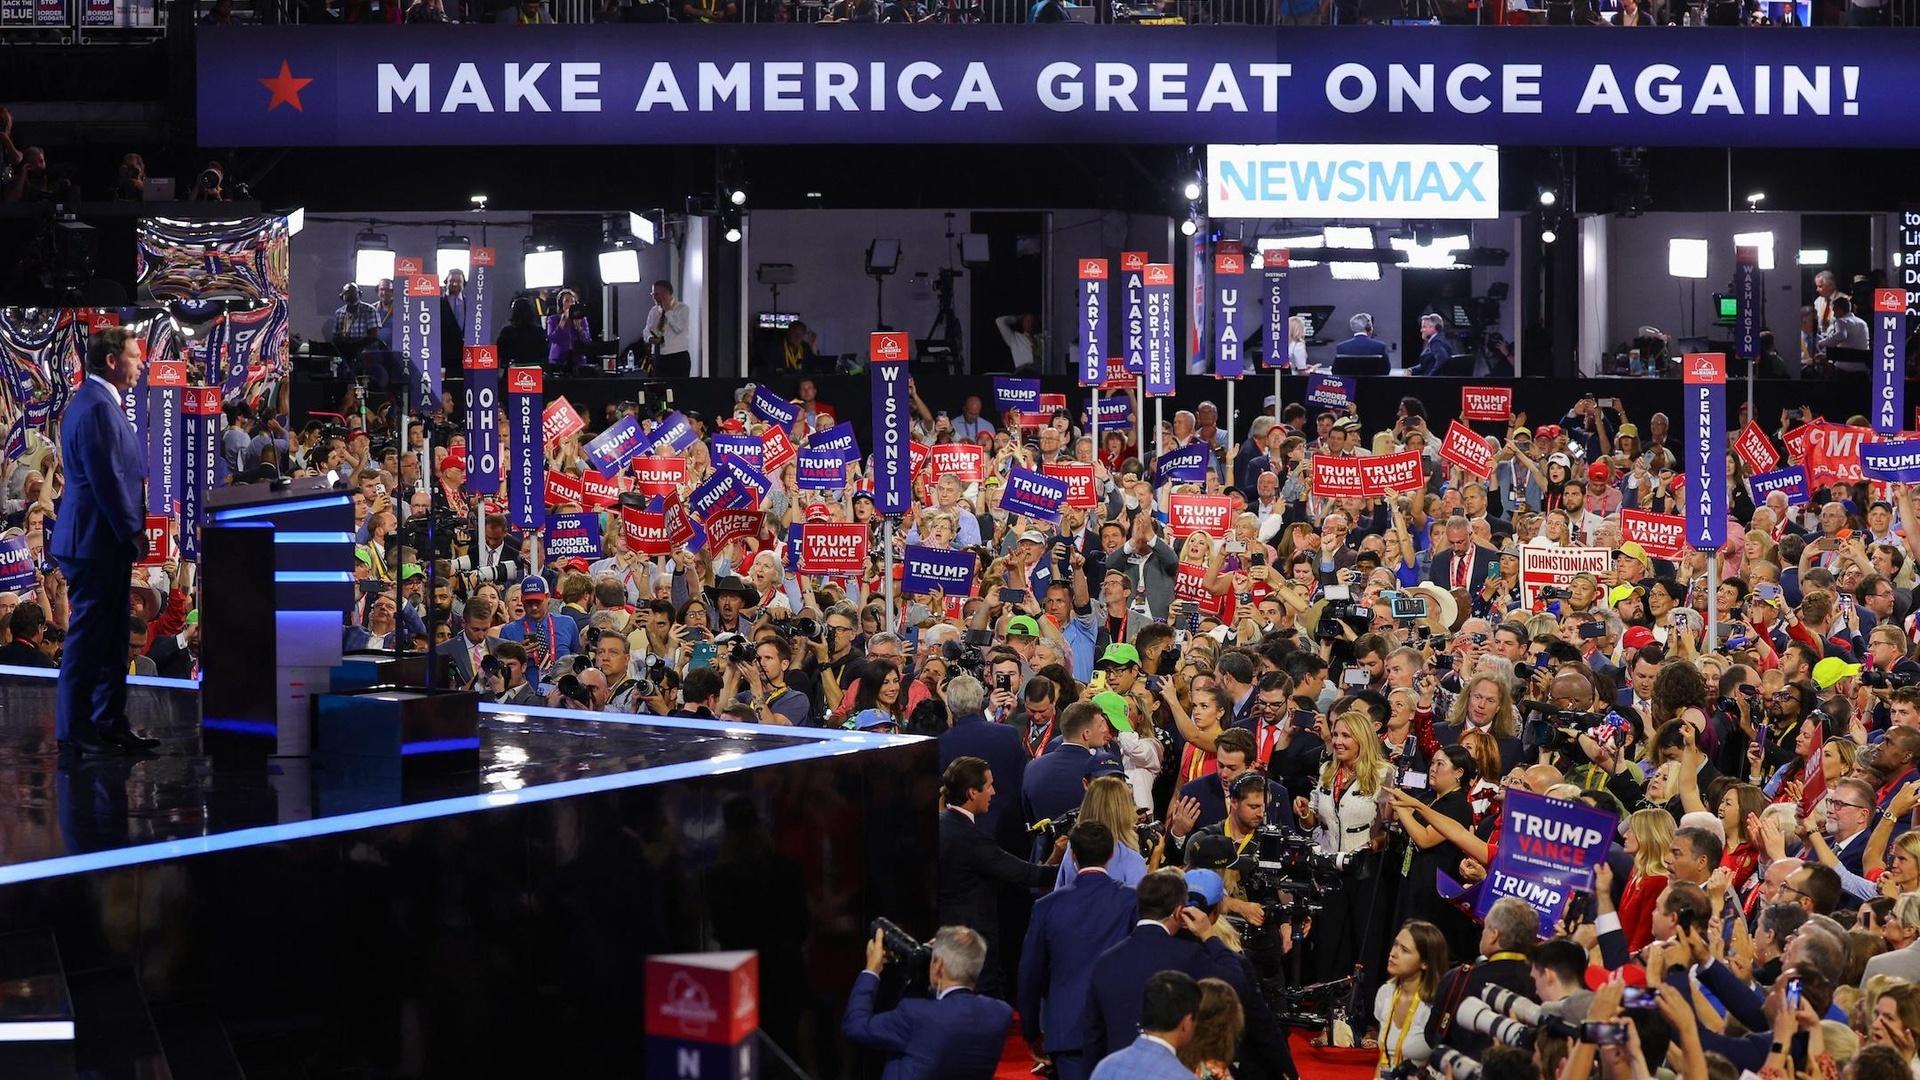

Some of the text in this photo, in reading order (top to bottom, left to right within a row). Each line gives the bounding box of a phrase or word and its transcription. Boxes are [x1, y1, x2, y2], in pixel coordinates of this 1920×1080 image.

[3, 9, 33, 19] BLUE
[378, 61, 1860, 116] MAKE AMERICA GREAT ONCE AGAIN!
[1220, 160, 1486, 203] NEWSMAX
[1128, 273, 1144, 366] ALASKA
[1743, 265, 1753, 353] WASHINGTON
[474, 303, 482, 347] CAROLI
[1087, 281, 1100, 380] MARYLAND
[1221, 288, 1238, 361] UTAH
[1271, 286, 1281, 359] COLUMBIA
[1148, 293, 1171, 385] NORTHERN MARIANA ISLANDS
[402, 325, 411, 376] DAKOTA
[419, 300, 432, 406] LOUISIANA
[1107, 372, 1133, 380] ANCE
[1881, 316, 1897, 428] MICHIGAN
[996, 388, 1036, 399] TRUMP
[1323, 379, 1343, 388] STOP
[1314, 390, 1347, 401] BORDER
[1466, 394, 1508, 404] TRUMP
[1470, 402, 1503, 411] VANCE
[543, 406, 569, 432] UMP
[755, 394, 793, 422] TRUMP
[465, 388, 475, 474] OHIO
[479, 387, 495, 474] OHIO
[881, 366, 899, 506] WISCONSIN
[162, 389, 173, 513] MASSACHUSETTS
[592, 425, 636, 459] TRUMP
[715, 443, 762, 456] TRUMP
[763, 433, 784, 453] UMP
[1451, 429, 1493, 459] TRUMP
[1452, 441, 1487, 465] VANCE
[1748, 429, 1774, 465] TRUMP
[206, 419, 215, 489] NEBR
[521, 396, 533, 524] NORTH CAROLINA
[763, 444, 785, 464] ANCE
[799, 457, 843, 469] TRUMP
[933, 452, 980, 463] TRUMP
[1160, 455, 1203, 474] TRUMP
[1700, 387, 1712, 541] PENNSYLVANIA
[1745, 439, 1767, 470] VANCE
[636, 470, 682, 482] TRUMP
[938, 462, 975, 471] VANCE
[1317, 464, 1357, 477] TRUM
[1363, 460, 1417, 477] TRUMP
[185, 419, 196, 551] NEBRASKA
[1013, 476, 1063, 500] TRUMP
[1322, 475, 1361, 485] VANCE
[1370, 471, 1413, 485] VANCE
[1755, 474, 1803, 493] TRUMP
[550, 480, 581, 502] TRUM
[584, 482, 619, 497] TRUM
[697, 476, 734, 511] TRUMP
[1015, 489, 1056, 508] VANCE
[1173, 504, 1227, 517] TRUMP
[1179, 515, 1221, 526] VANCE
[556, 519, 581, 530] STOP
[709, 512, 759, 535] TRUMP
[713, 520, 750, 542] VANCE
[1626, 518, 1684, 536] TRUMP
[551, 537, 589, 546] BORDER
[807, 535, 863, 547] TRUMP
[1631, 530, 1676, 546] VANCE
[0, 548, 29, 565] RUMP
[547, 544, 597, 556] BLOODBATH
[812, 547, 856, 557] VANCE
[910, 561, 969, 578] TRUMP
[1527, 553, 1604, 572] JOHNSTONIANS
[1511, 811, 1602, 849] TRUMP
[1519, 835, 1586, 865] VANCE
[1494, 870, 1561, 908] TRUMP
